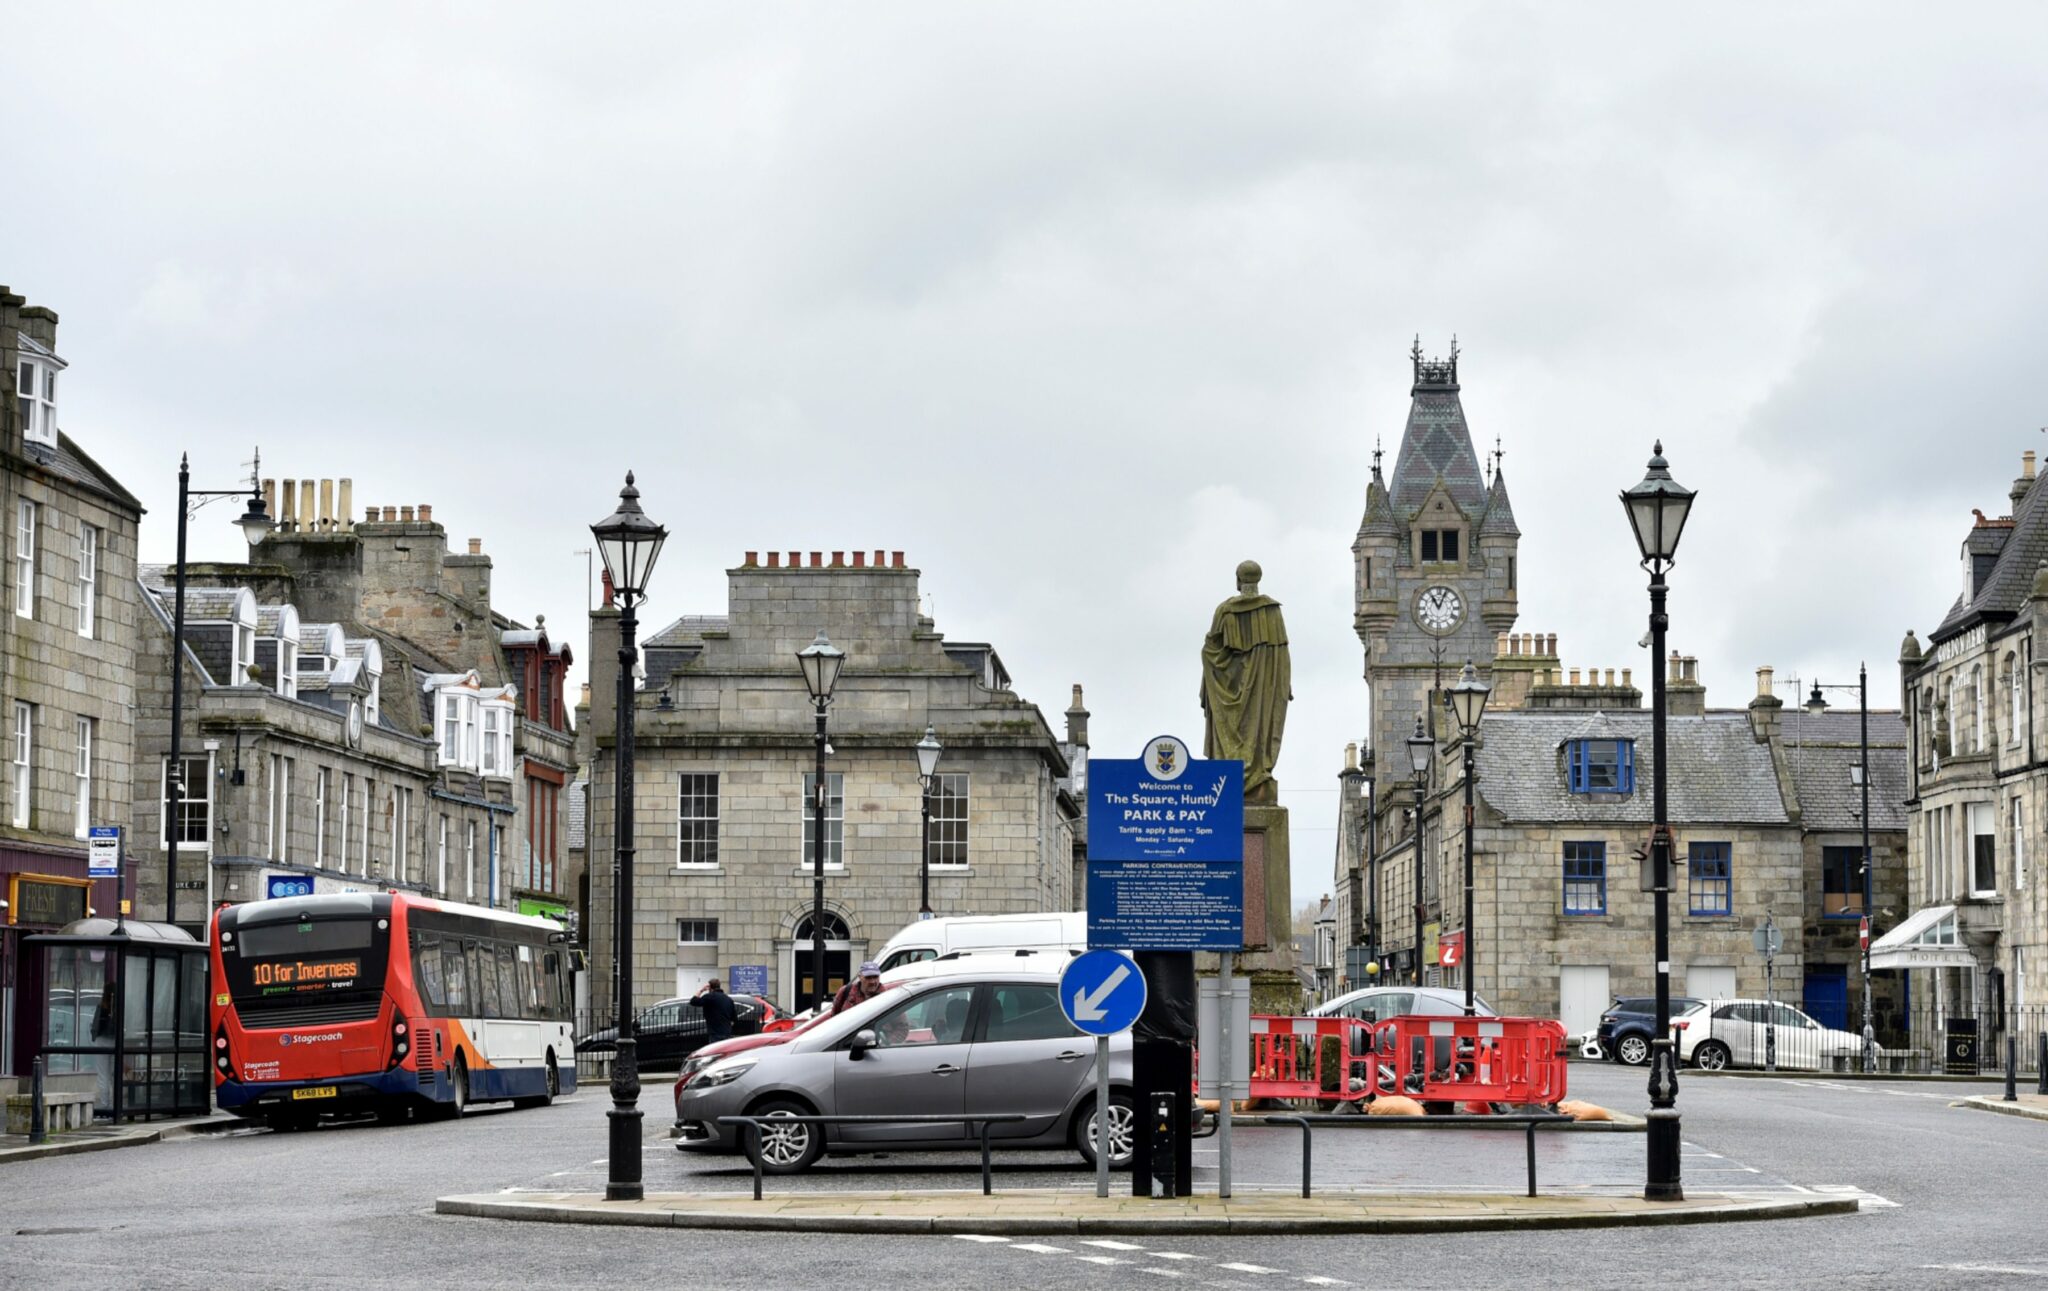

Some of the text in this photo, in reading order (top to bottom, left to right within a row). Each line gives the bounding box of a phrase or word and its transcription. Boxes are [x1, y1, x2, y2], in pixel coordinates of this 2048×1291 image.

[1138, 782, 1194, 791] Welcome to
[1104, 793, 1220, 807] The Square, Huntly
[1123, 809, 1207, 821] PARK & PAY
[1118, 826, 1142, 834] Tariffs
[1145, 826, 1166, 836] apply
[1168, 826, 1186, 834] 8am
[1195, 826, 1213, 836] 5pm
[1135, 836, 1160, 844] Monday
[1167, 836, 1195, 844] Saturday
[274, 884, 307, 895] TSB
[25, 883, 57, 913] FRESH
[1909, 953, 1962, 962] HOTEL
[253, 961, 358, 986] 10 for Inverness
[262, 979, 353, 996] greener smarter travel
[292, 1031, 343, 1045] Stagecoach
[244, 1060, 281, 1070] Stagecoach
